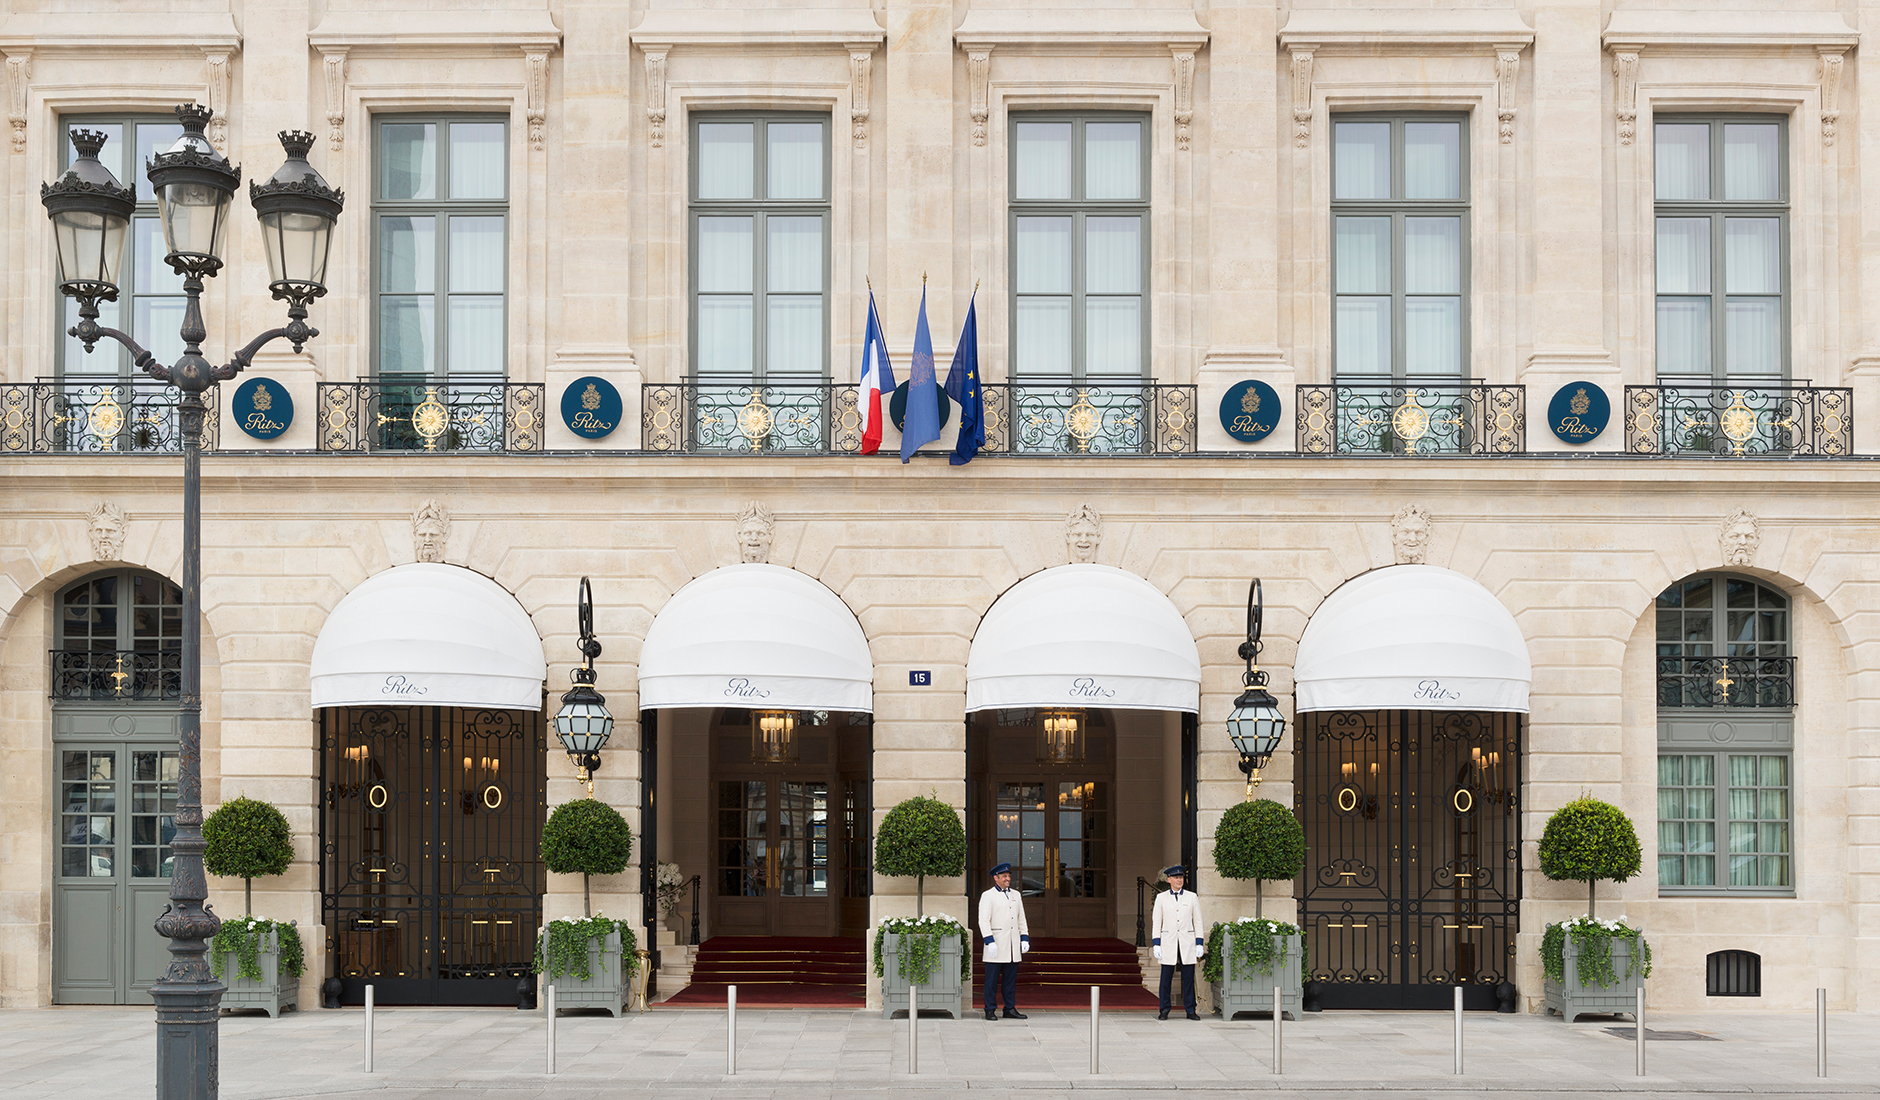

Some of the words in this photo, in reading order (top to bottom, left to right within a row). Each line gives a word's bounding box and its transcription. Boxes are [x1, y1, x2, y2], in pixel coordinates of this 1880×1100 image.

[245, 412, 284, 430] Ritz
[571, 411, 612, 430] Ritz
[1229, 414, 1270, 433] Ritz
[1556, 416, 1598, 435] Ritz
[381, 675, 428, 695] Ritz
[914, 673, 926, 683] 15
[1069, 677, 1116, 698] Ritz
[724, 677, 771, 699] Ritz
[1413, 679, 1461, 701] Ritz
